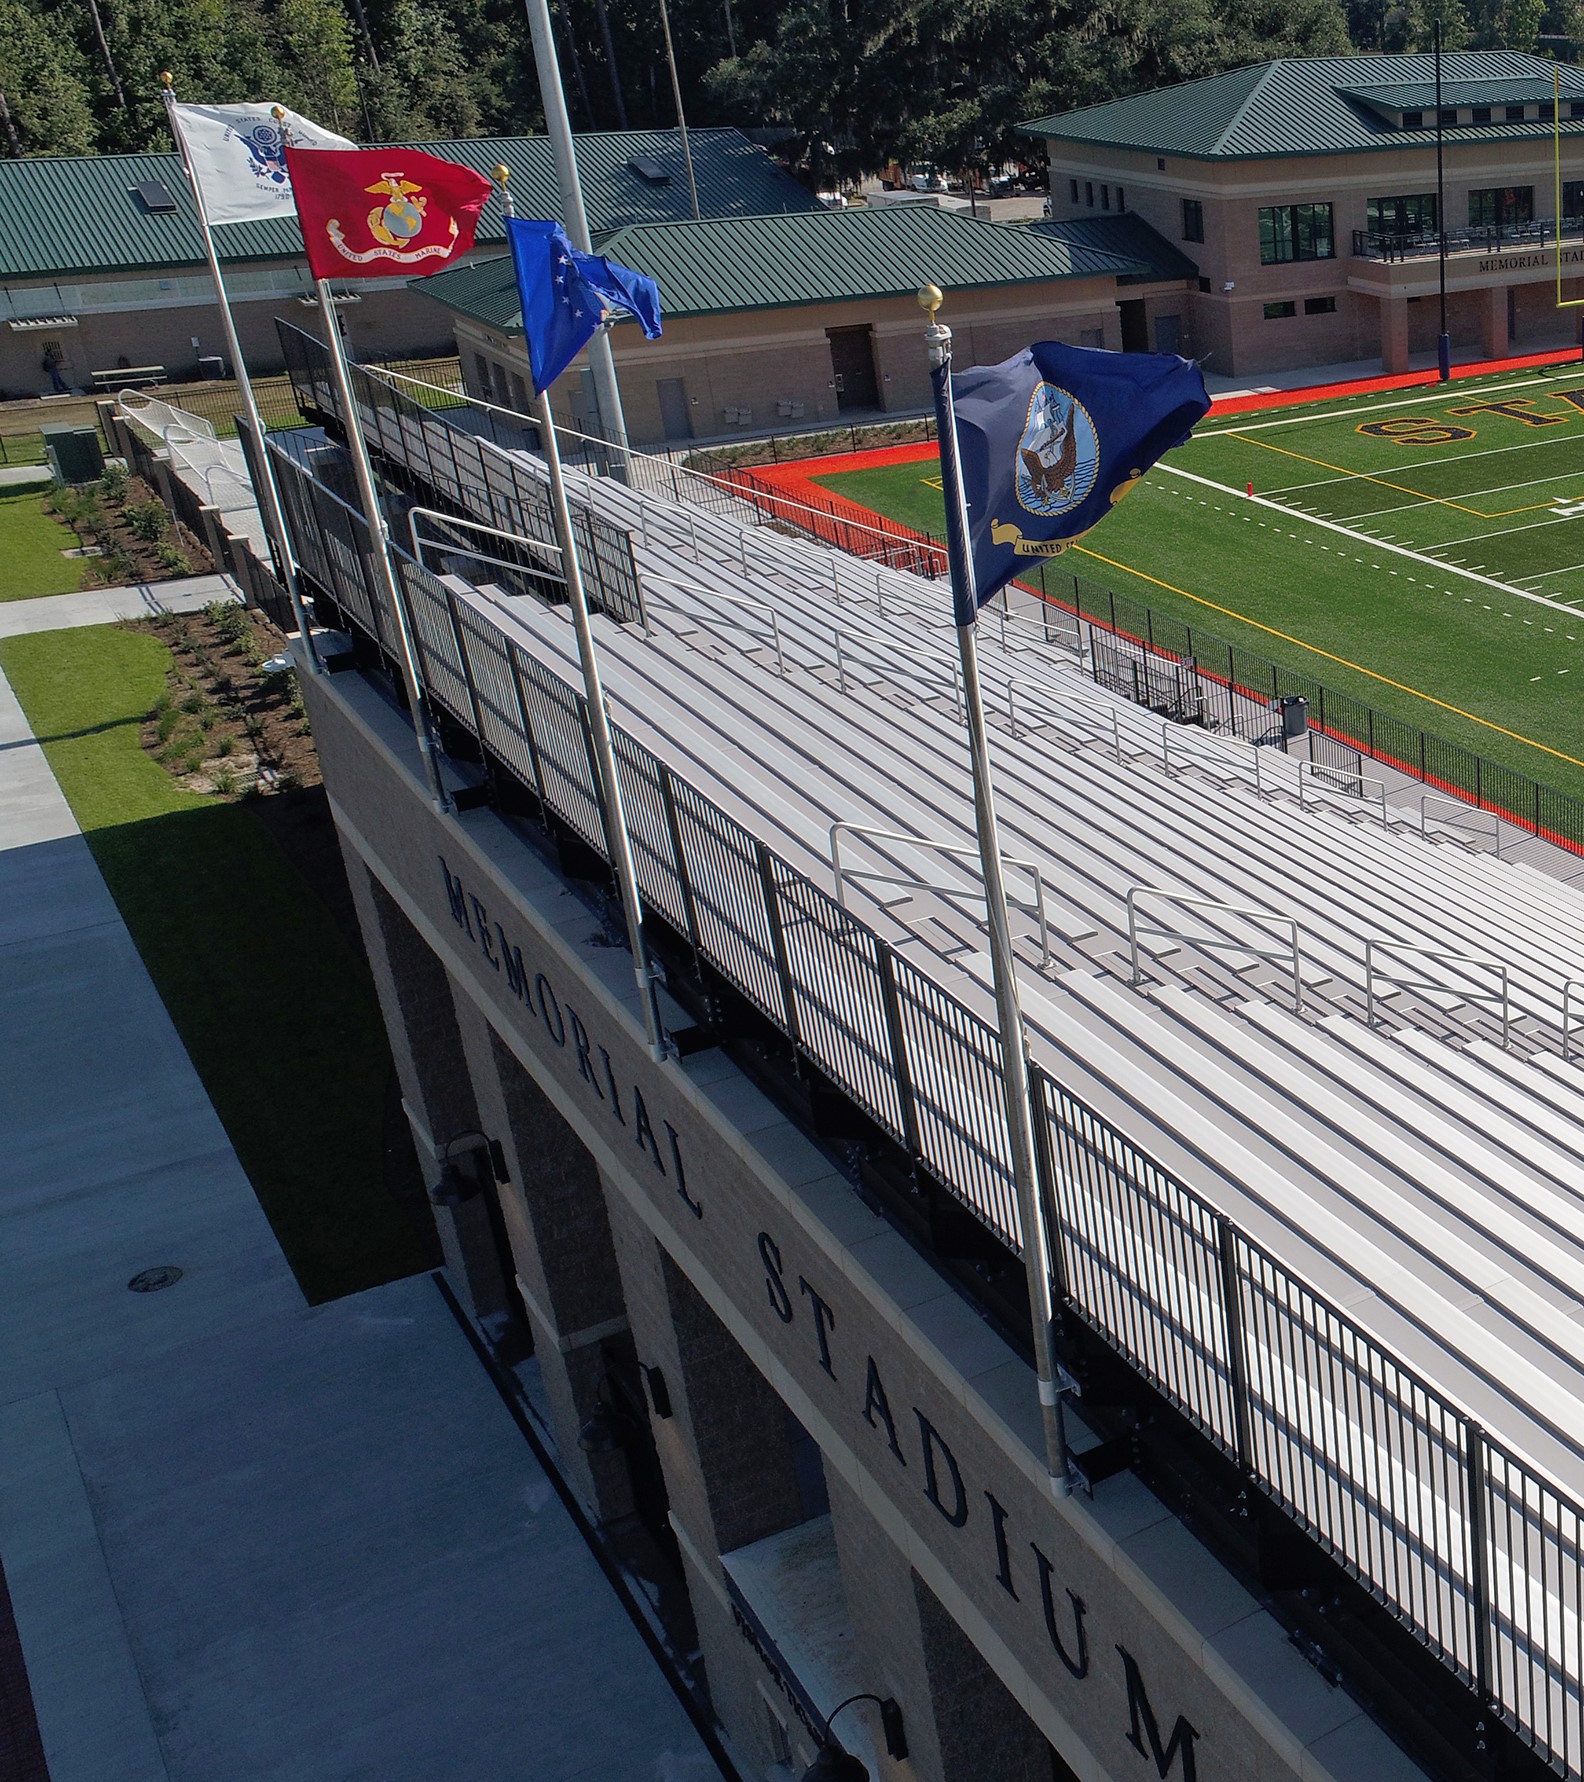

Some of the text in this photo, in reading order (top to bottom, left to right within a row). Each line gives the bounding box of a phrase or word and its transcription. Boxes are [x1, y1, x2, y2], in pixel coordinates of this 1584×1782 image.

[235, 116, 261, 124] STATES
[268, 117, 291, 128] COST
[255, 183, 279, 193] SEMPER
[336, 243, 441, 261] UNITED STATES MARINE
[1479, 255, 1549, 272] MEMORIAL
[1022, 543, 1062, 554] UNITED
[438, 854, 1200, 1782] MEMORIAL STADIUM
